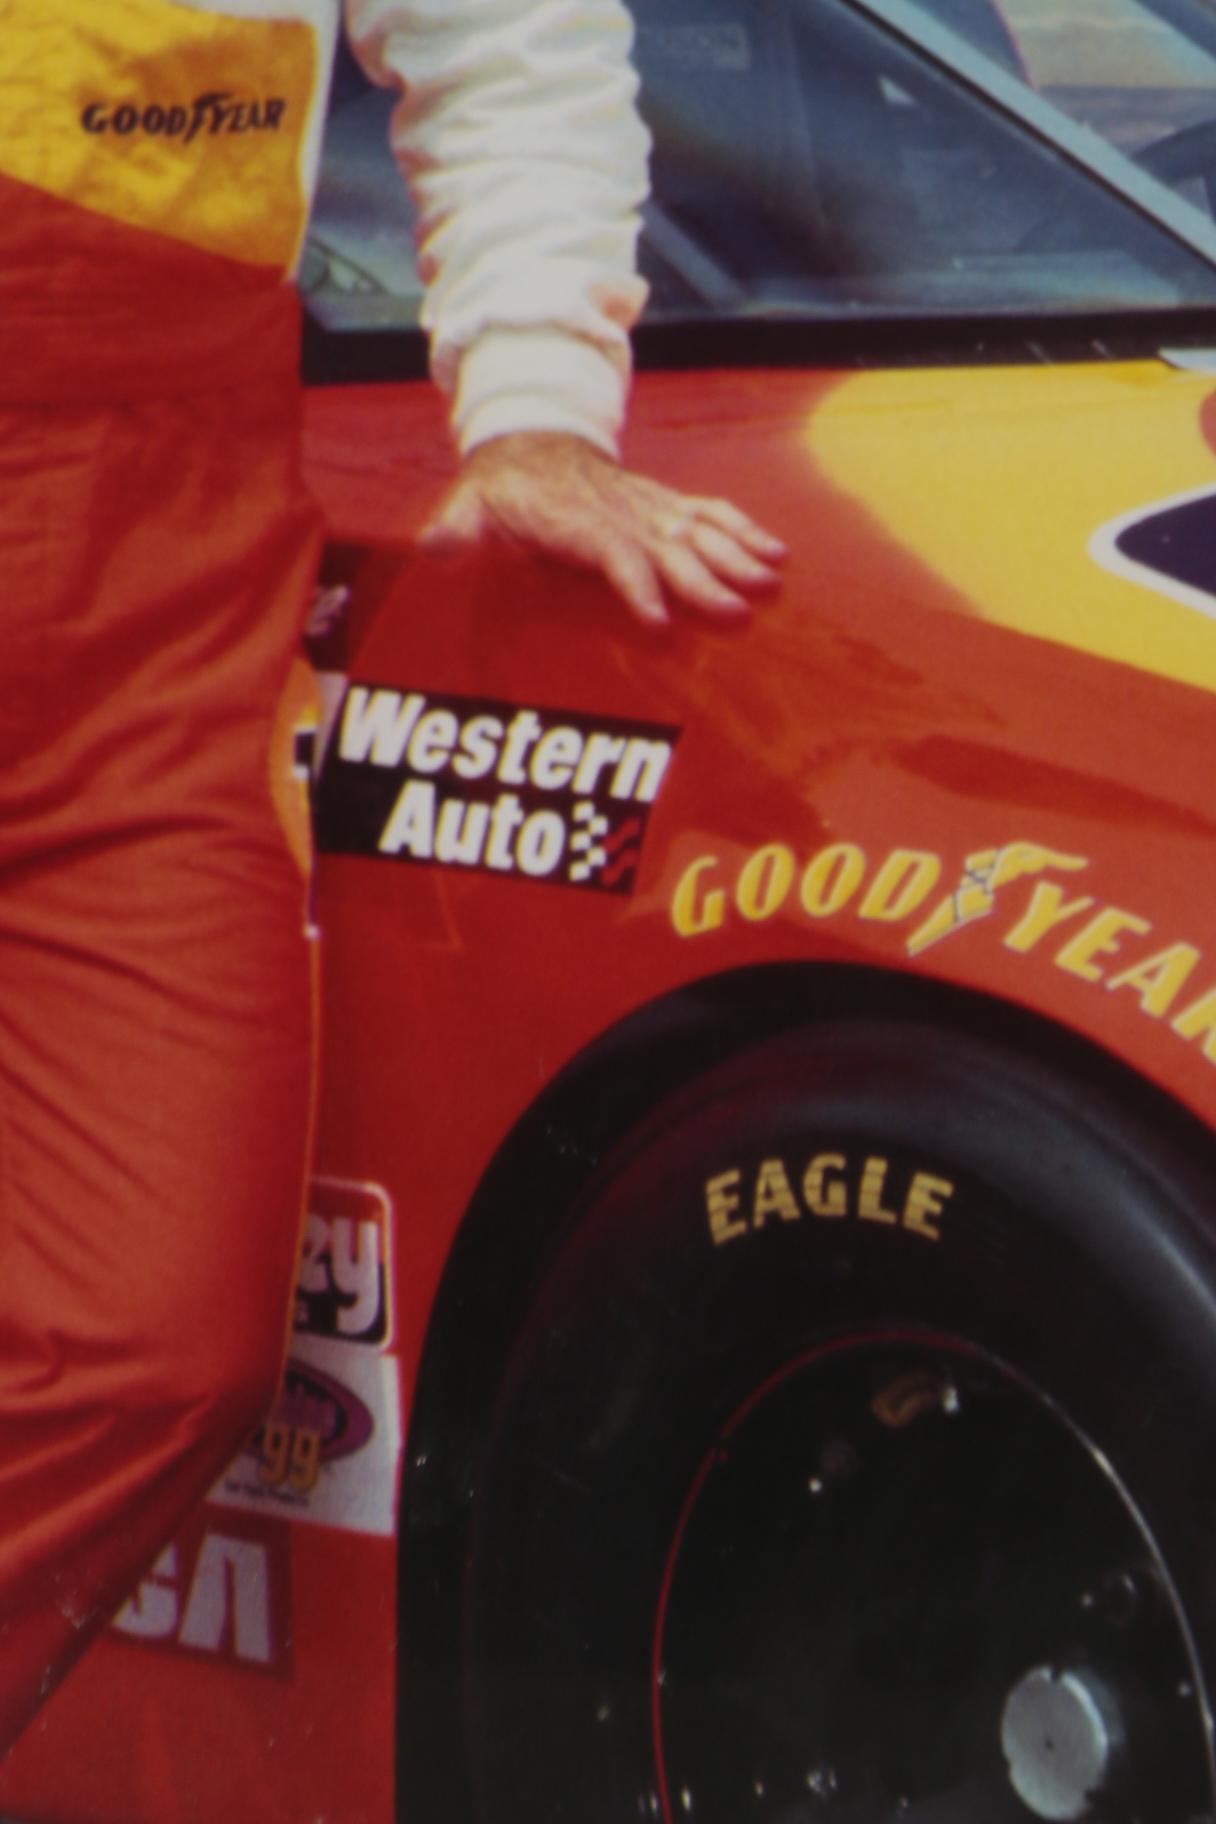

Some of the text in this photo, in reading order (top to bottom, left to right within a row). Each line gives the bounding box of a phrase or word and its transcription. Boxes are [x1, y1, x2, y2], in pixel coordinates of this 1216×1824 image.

[81, 90, 286, 144] GOODYEAR
[338, 684, 673, 803] Western
[377, 778, 567, 876] Auto
[706, 1152, 954, 1245] EAGLE
